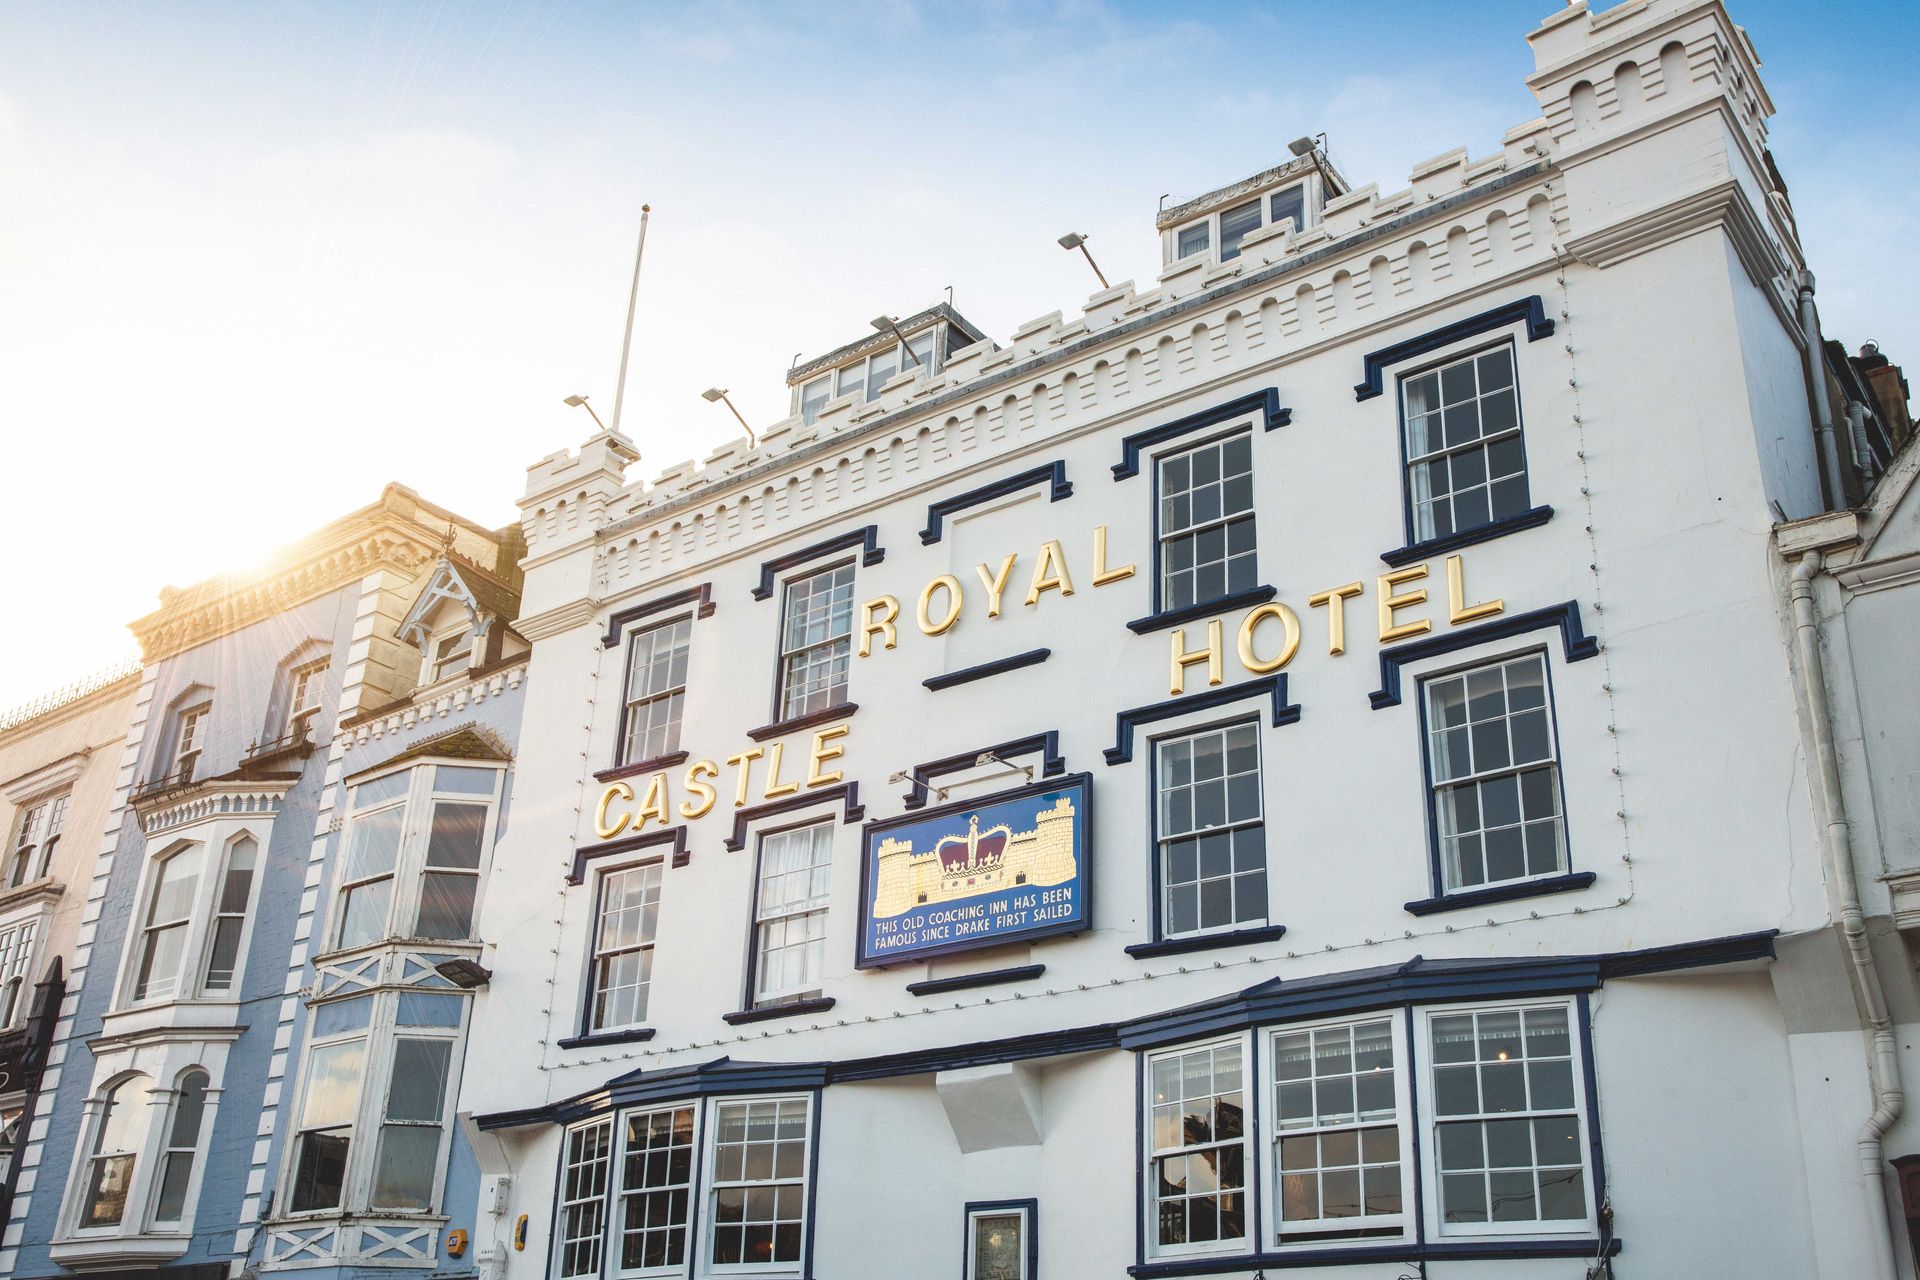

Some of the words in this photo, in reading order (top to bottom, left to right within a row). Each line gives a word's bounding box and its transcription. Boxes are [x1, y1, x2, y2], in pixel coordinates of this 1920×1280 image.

[859, 525, 1136, 658] ROYAL
[1170, 554, 1504, 695] HOTEL
[594, 724, 849, 839] CASTLE
[875, 931, 917, 950] FAMOUS
[921, 925, 949, 942] SINCE
[955, 918, 990, 936] DRAKE
[996, 911, 1027, 929] FIRST
[1033, 903, 1073, 922] SAILED
[876, 920, 897, 935] THIS
[902, 916, 924, 931] OLD
[928, 904, 984, 925] COACHING
[989, 899, 1008, 915] INN
[1014, 894, 1036, 910] HAS
[1042, 887, 1072, 904] BEEN
